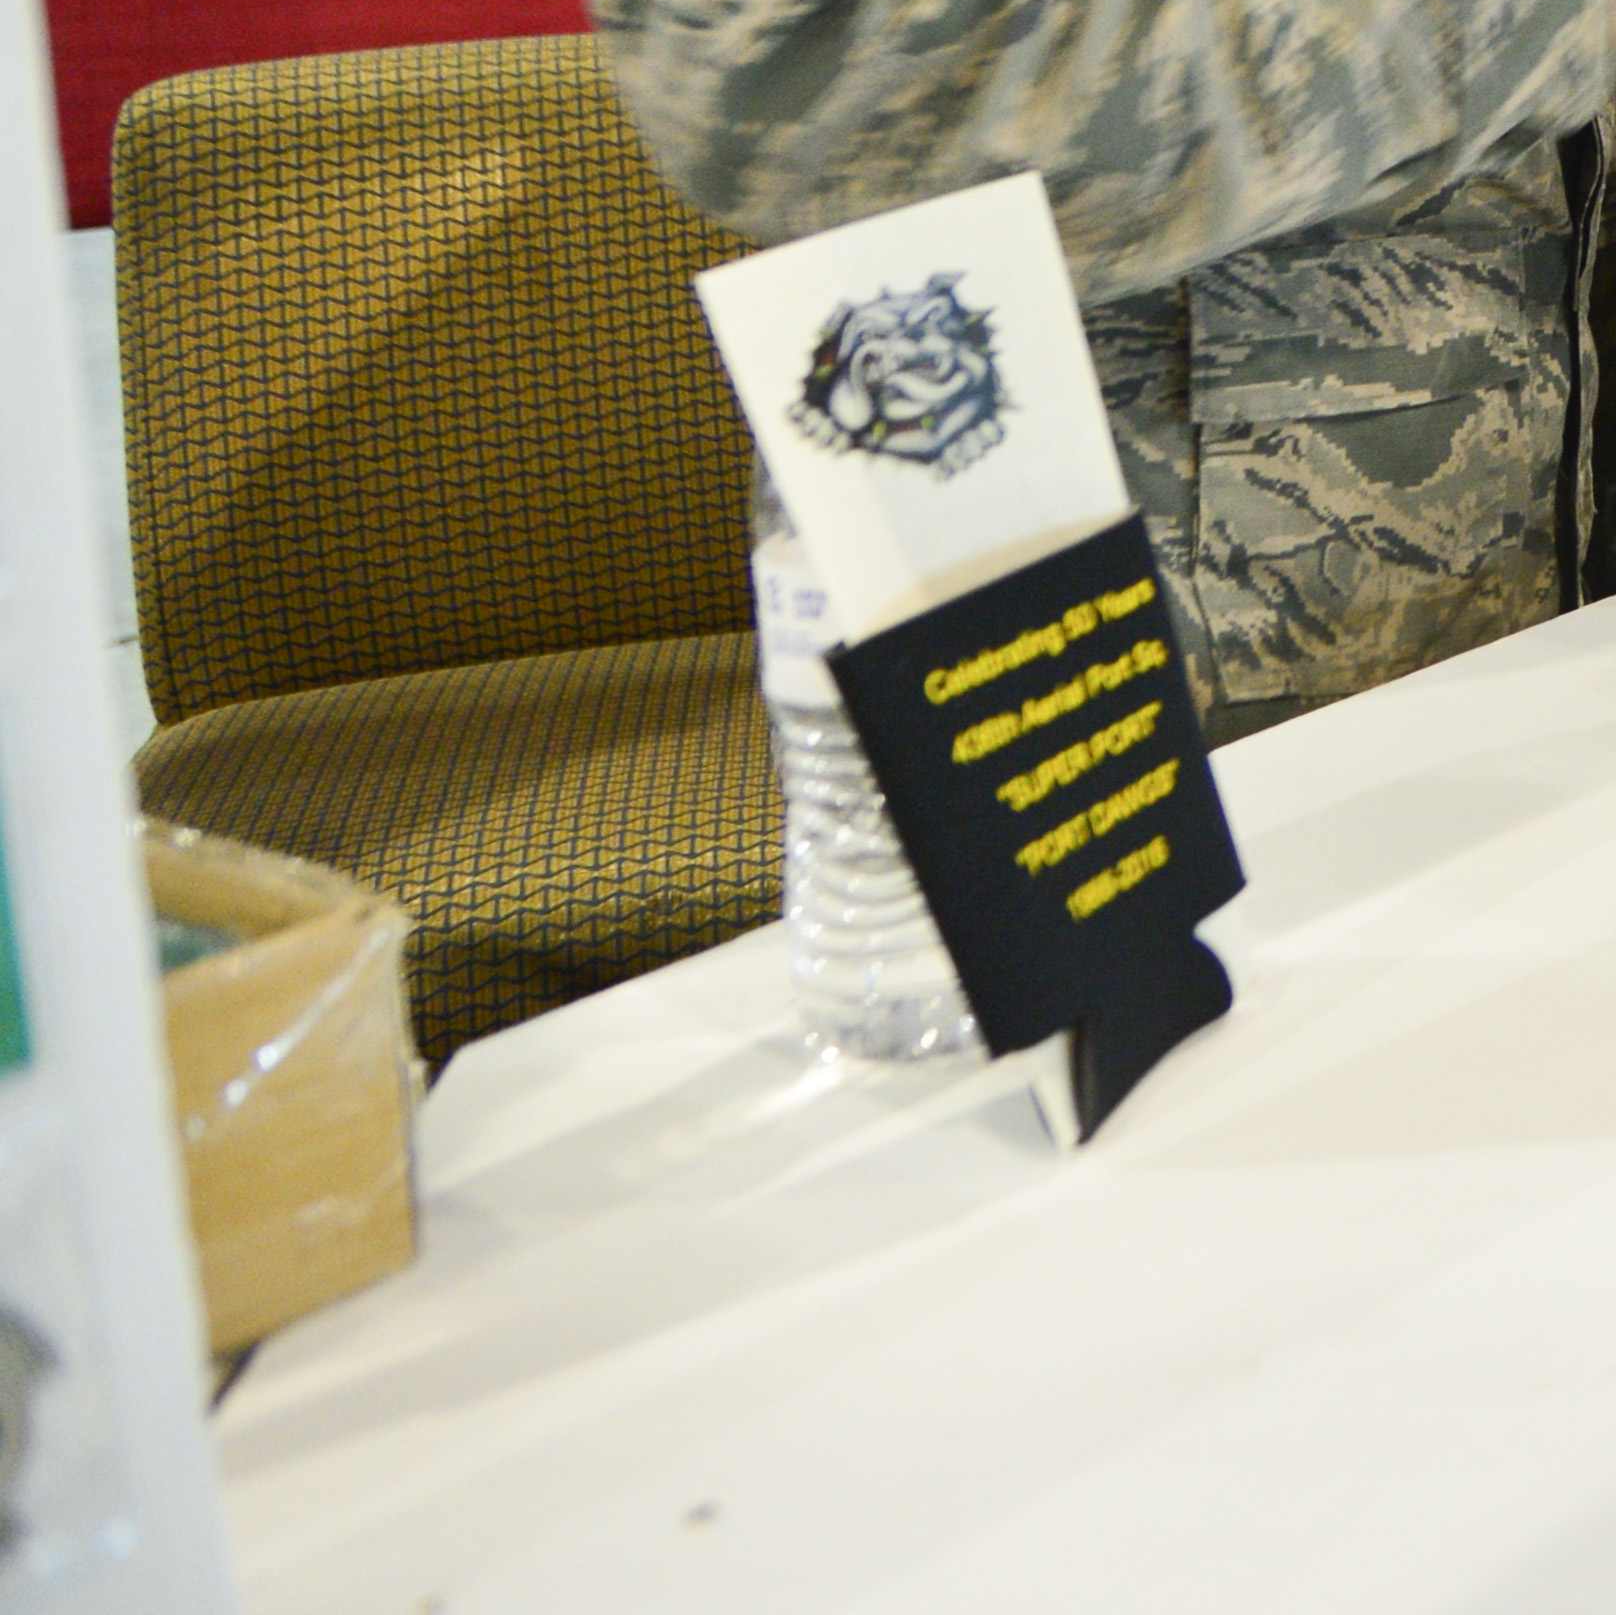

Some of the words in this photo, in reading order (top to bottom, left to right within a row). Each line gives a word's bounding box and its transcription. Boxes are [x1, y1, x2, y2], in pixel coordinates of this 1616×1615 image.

[924, 622, 1068, 704] Celebrating
[1061, 602, 1098, 640] 50
[1093, 578, 1155, 622] Years
[1016, 675, 1092, 733] Aerial
[1082, 653, 1137, 697] Port
